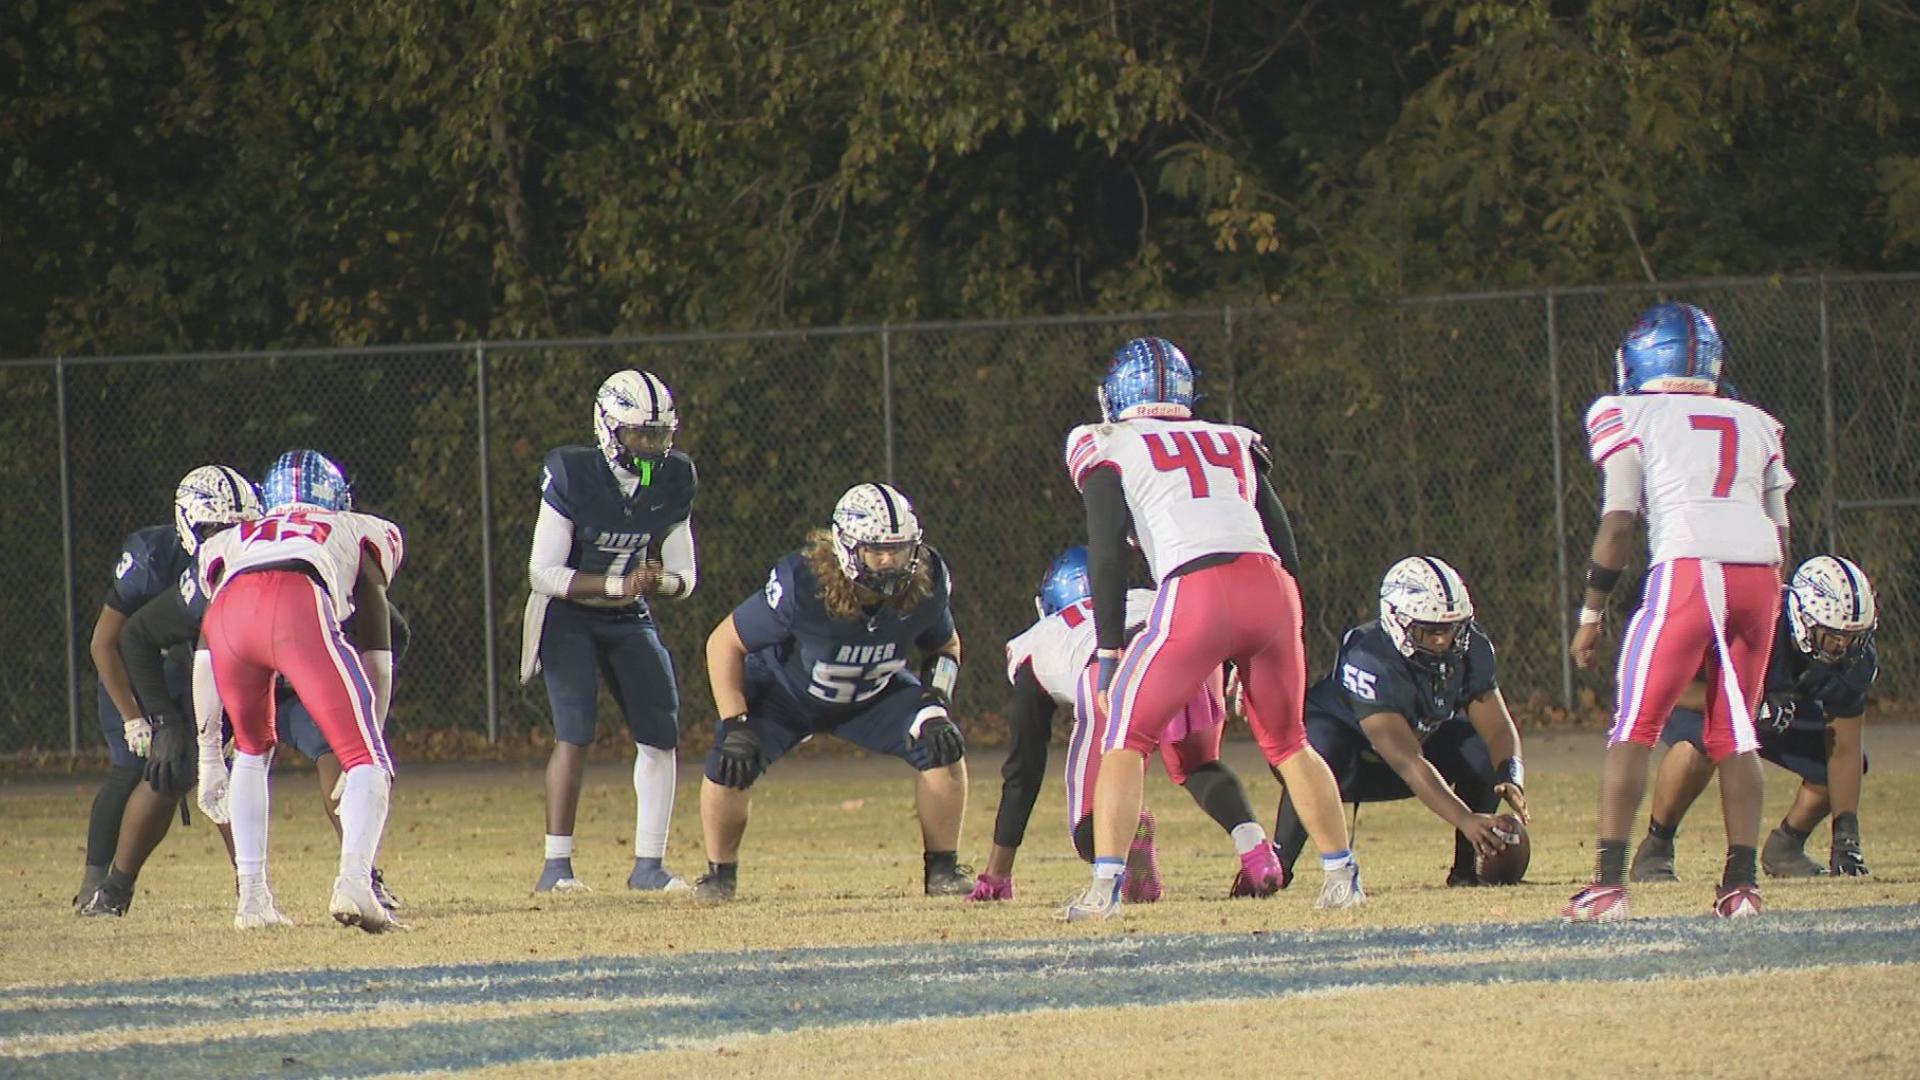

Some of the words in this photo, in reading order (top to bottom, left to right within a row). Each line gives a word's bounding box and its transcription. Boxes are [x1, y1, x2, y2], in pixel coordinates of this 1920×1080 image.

[1140, 431, 1249, 503] 44
[1688, 414, 1739, 498] 7
[593, 532, 652, 548] RIVER
[834, 642, 896, 664] RIVER
[807, 659, 907, 703] 53
[1342, 662, 1378, 700] 55
